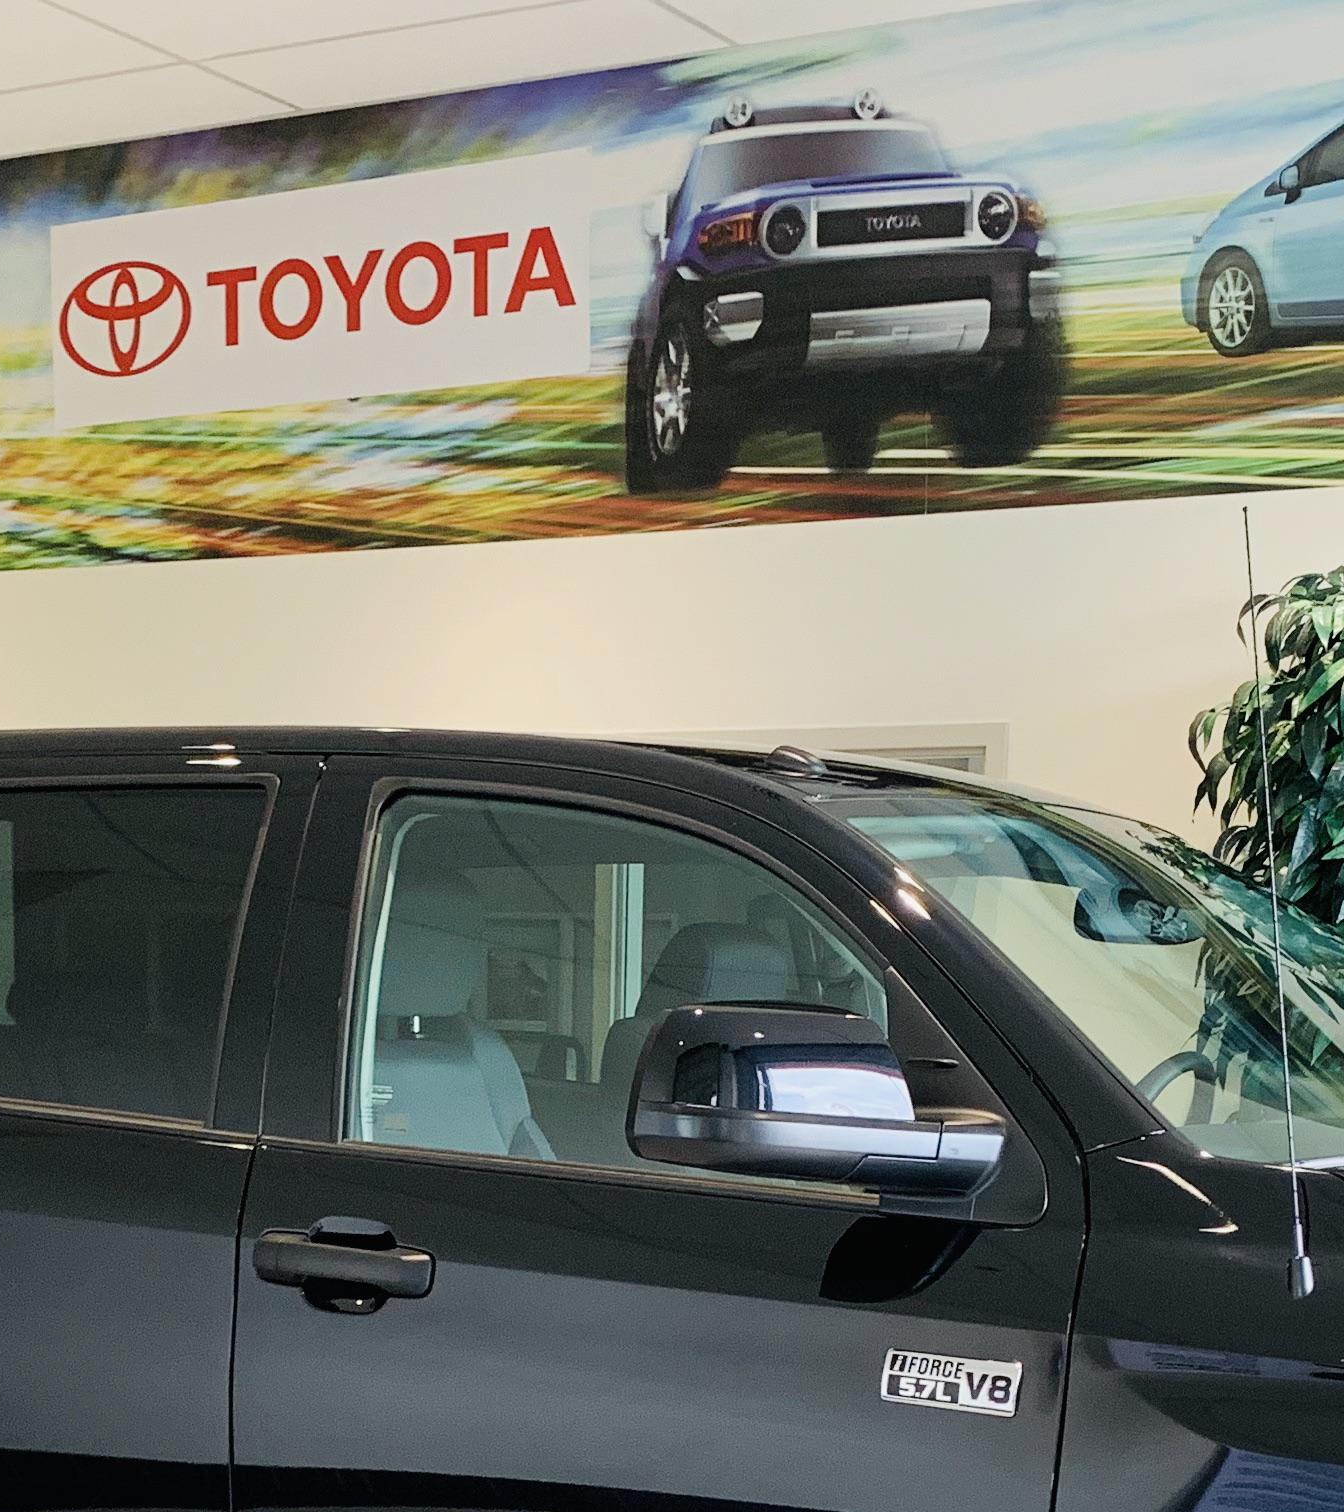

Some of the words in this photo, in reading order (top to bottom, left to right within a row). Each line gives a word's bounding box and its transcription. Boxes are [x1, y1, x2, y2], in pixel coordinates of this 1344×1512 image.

[865, 214, 922, 232] TOYOTA
[207, 227, 575, 346] TOYOTA
[898, 1376, 952, 1402] 5.7L
[965, 1372, 1013, 1404] V8
